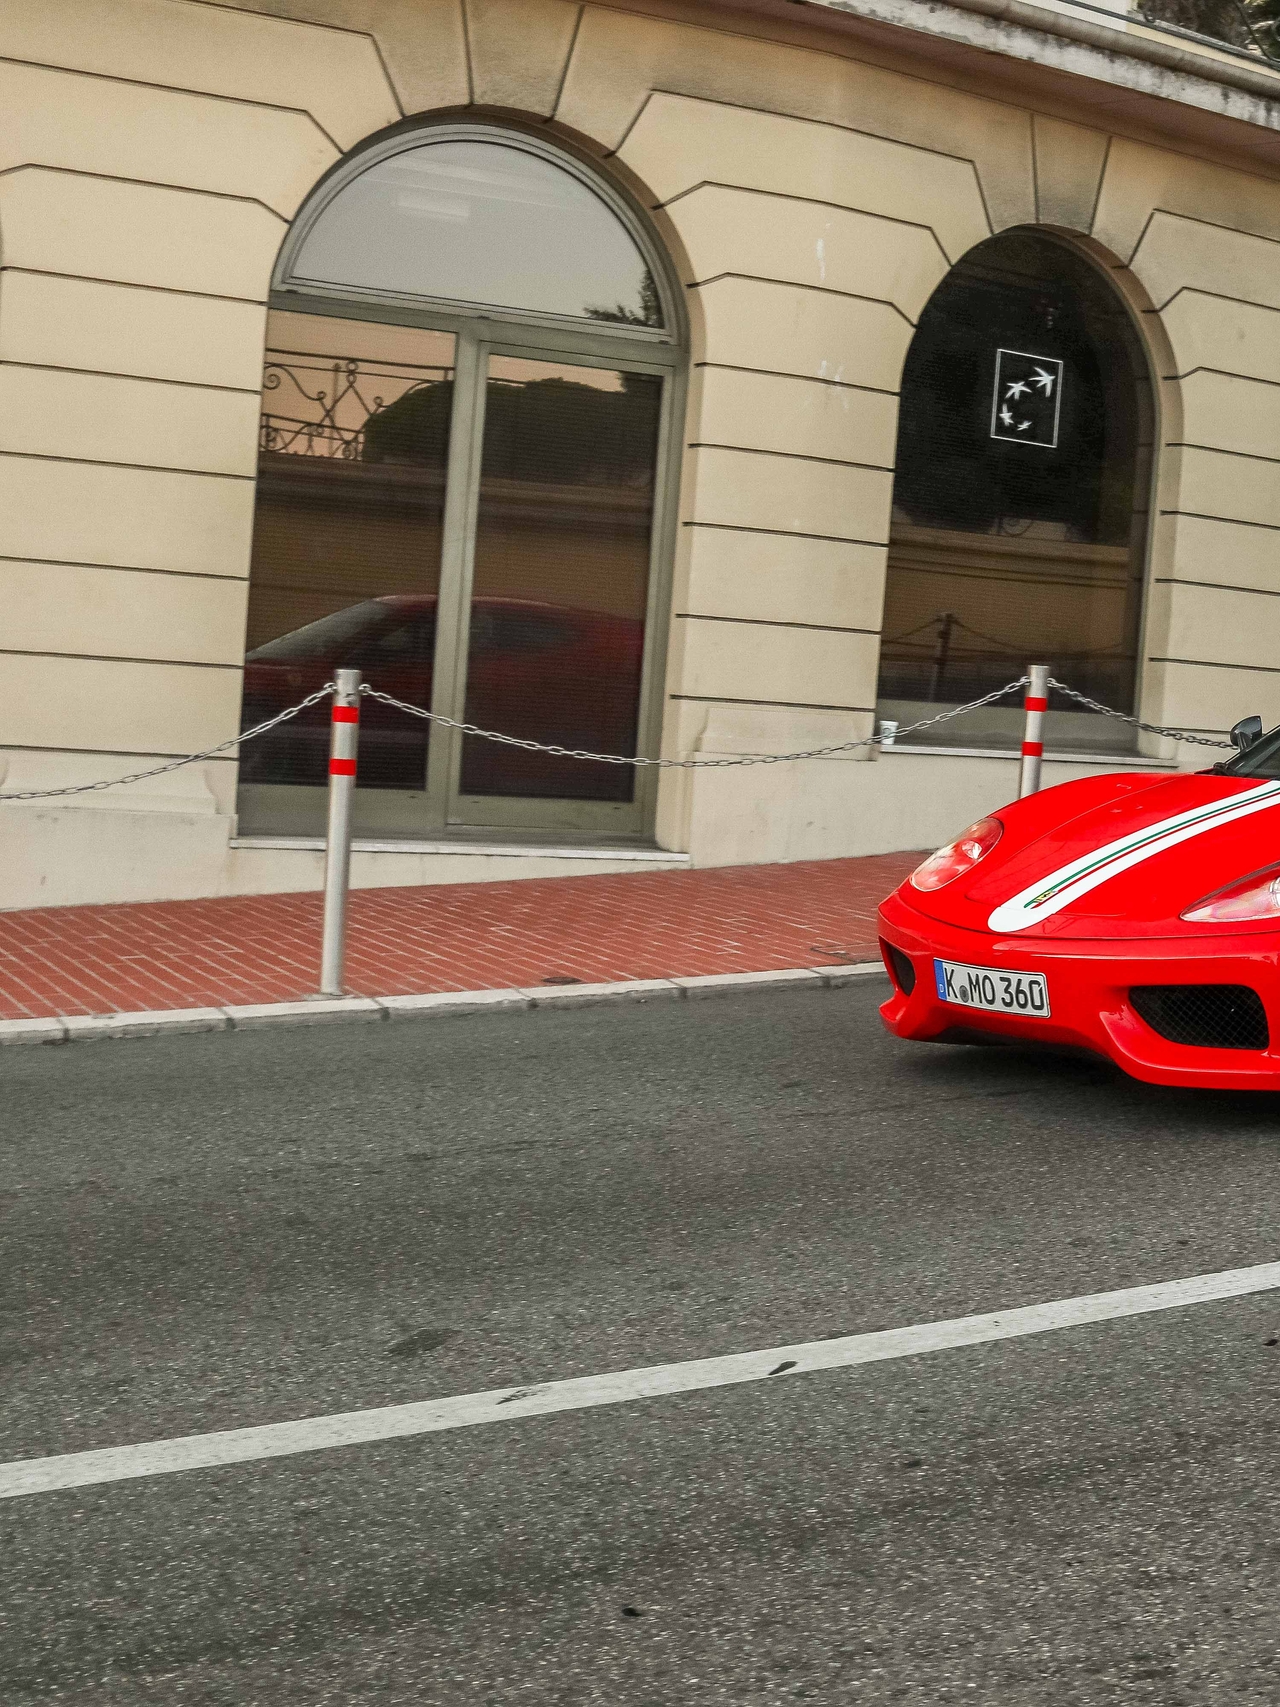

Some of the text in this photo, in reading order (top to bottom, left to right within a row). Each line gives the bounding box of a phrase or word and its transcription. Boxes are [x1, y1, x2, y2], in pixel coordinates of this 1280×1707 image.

[945, 967, 1045, 1011] K MO 360
